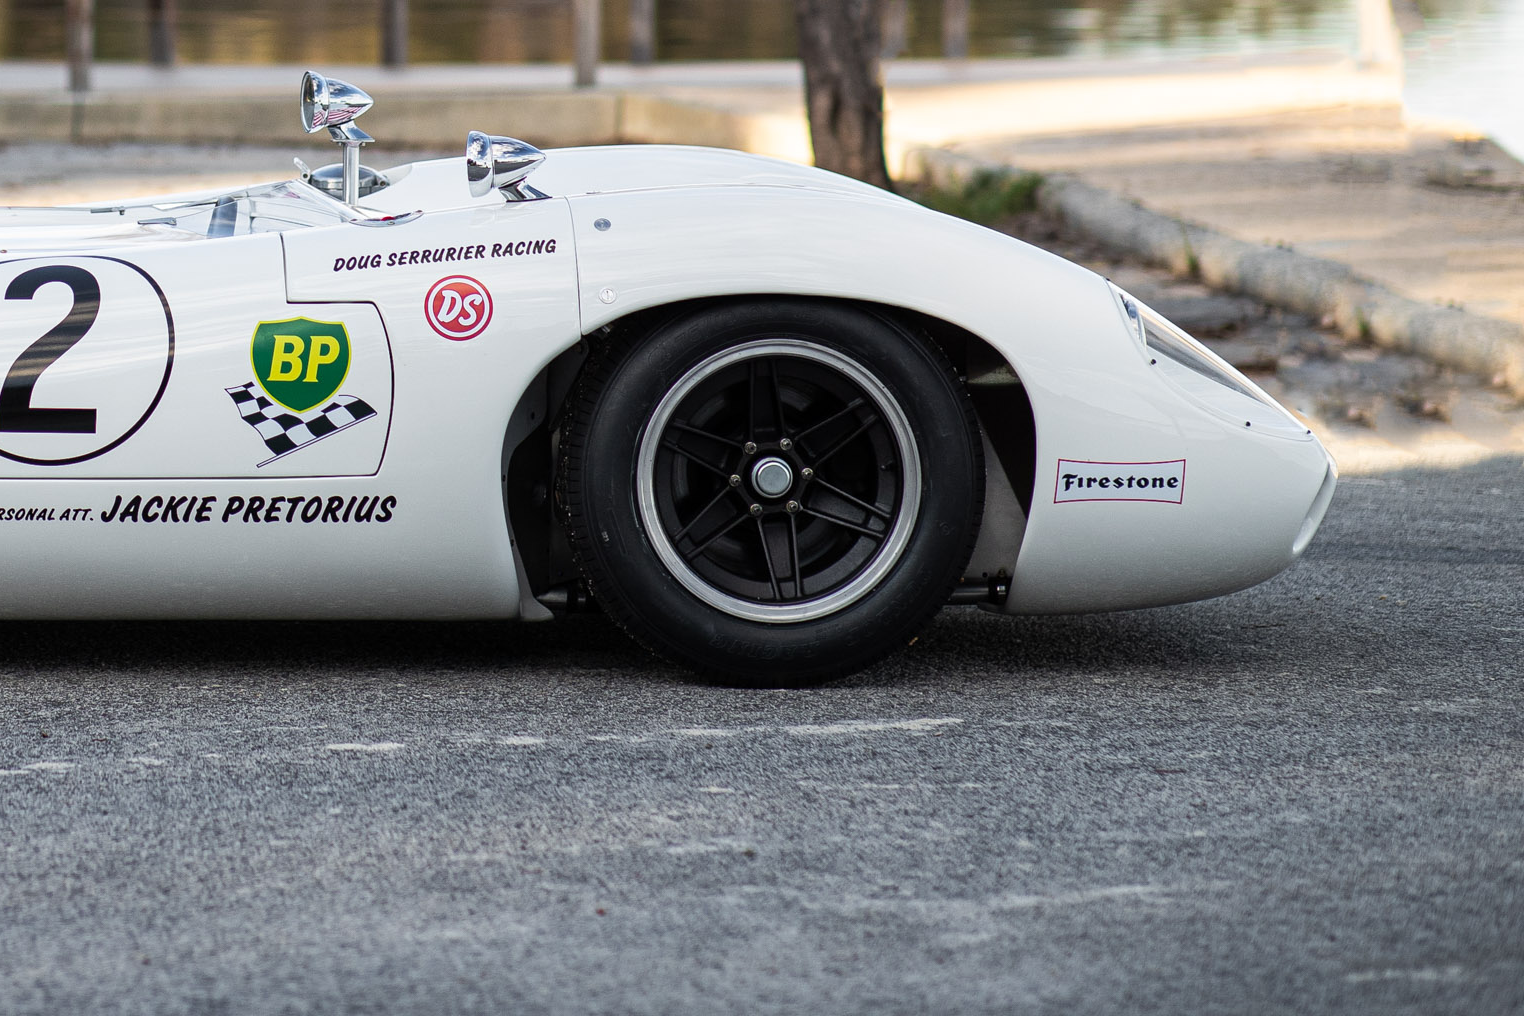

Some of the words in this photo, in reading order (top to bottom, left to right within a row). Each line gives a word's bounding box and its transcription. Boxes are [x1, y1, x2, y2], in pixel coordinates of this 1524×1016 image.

[333, 254, 383, 272] DOUG
[386, 244, 487, 267] SERRURIER
[491, 238, 558, 261] RACING
[437, 289, 483, 326] DS
[266, 334, 340, 383] BP
[1061, 473, 1180, 492] Firestone
[58, 507, 95, 522] ATT.
[100, 494, 217, 523] JACKIE
[221, 495, 399, 524] PRETORIUS
